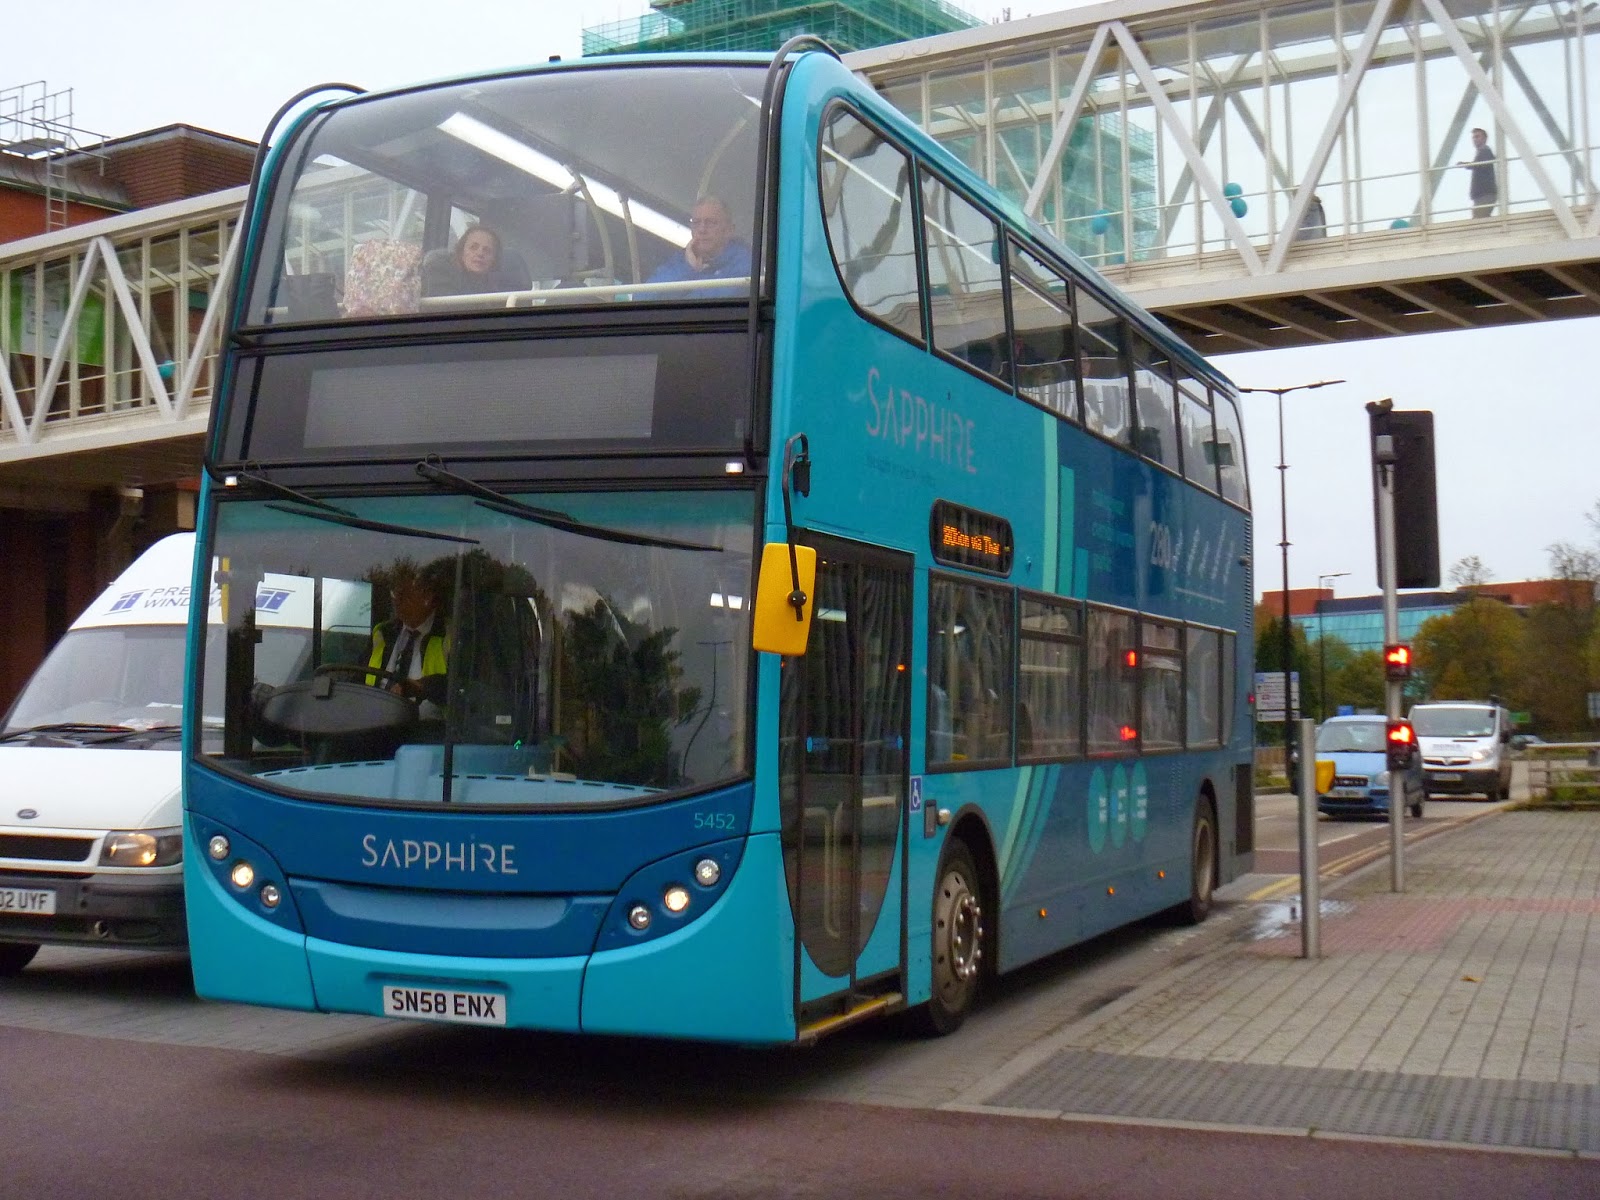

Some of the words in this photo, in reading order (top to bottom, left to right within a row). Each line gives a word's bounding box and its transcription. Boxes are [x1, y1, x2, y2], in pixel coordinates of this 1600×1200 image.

[865, 366, 978, 475] SAPPHIRE
[694, 812, 736, 830] 5452
[361, 833, 519, 875] SAPPHIRE
[18, 892, 48, 910] UYF
[391, 989, 447, 1014] SN58
[453, 993, 496, 1018] ENX
